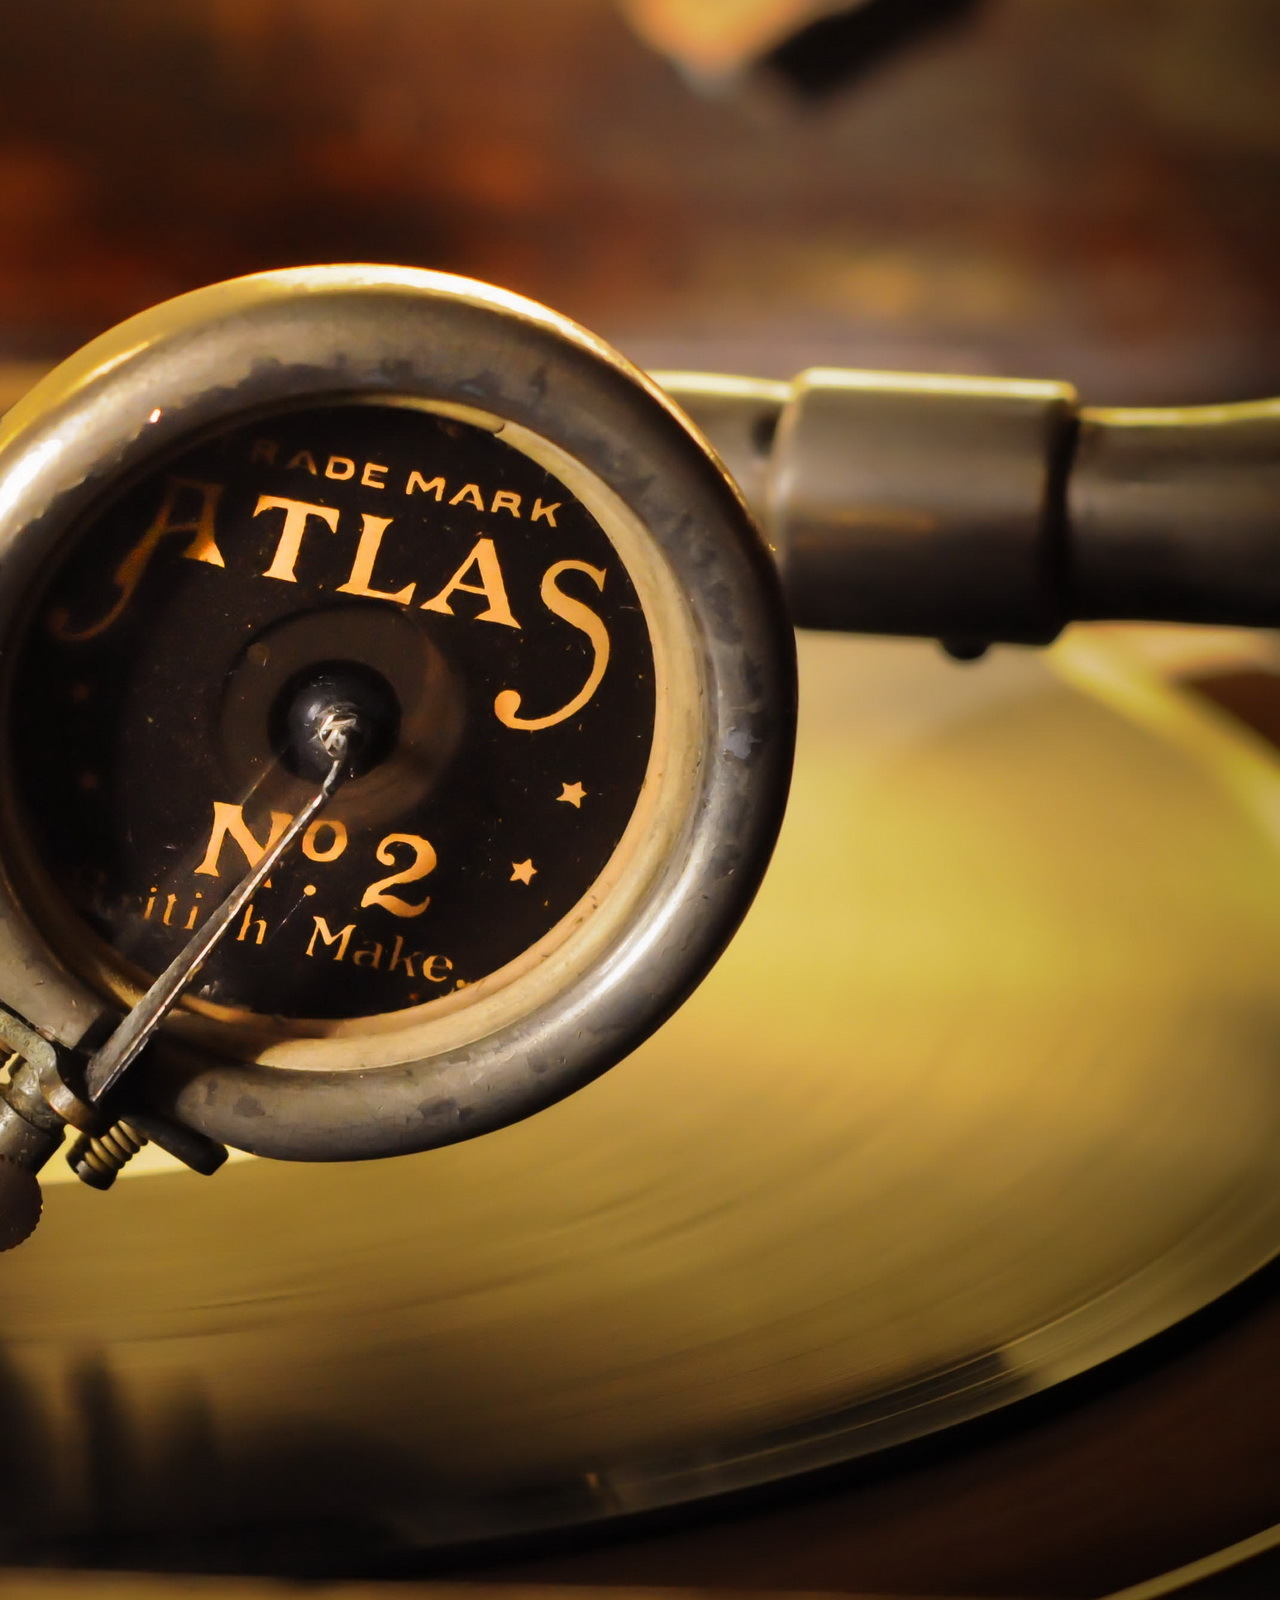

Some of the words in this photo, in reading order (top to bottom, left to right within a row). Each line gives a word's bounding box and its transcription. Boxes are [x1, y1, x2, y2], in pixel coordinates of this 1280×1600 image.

[250, 437, 389, 490] RADE
[405, 470, 562, 528] MARK
[46, 475, 610, 731] ATLAS
[360, 832, 438, 918] 2
